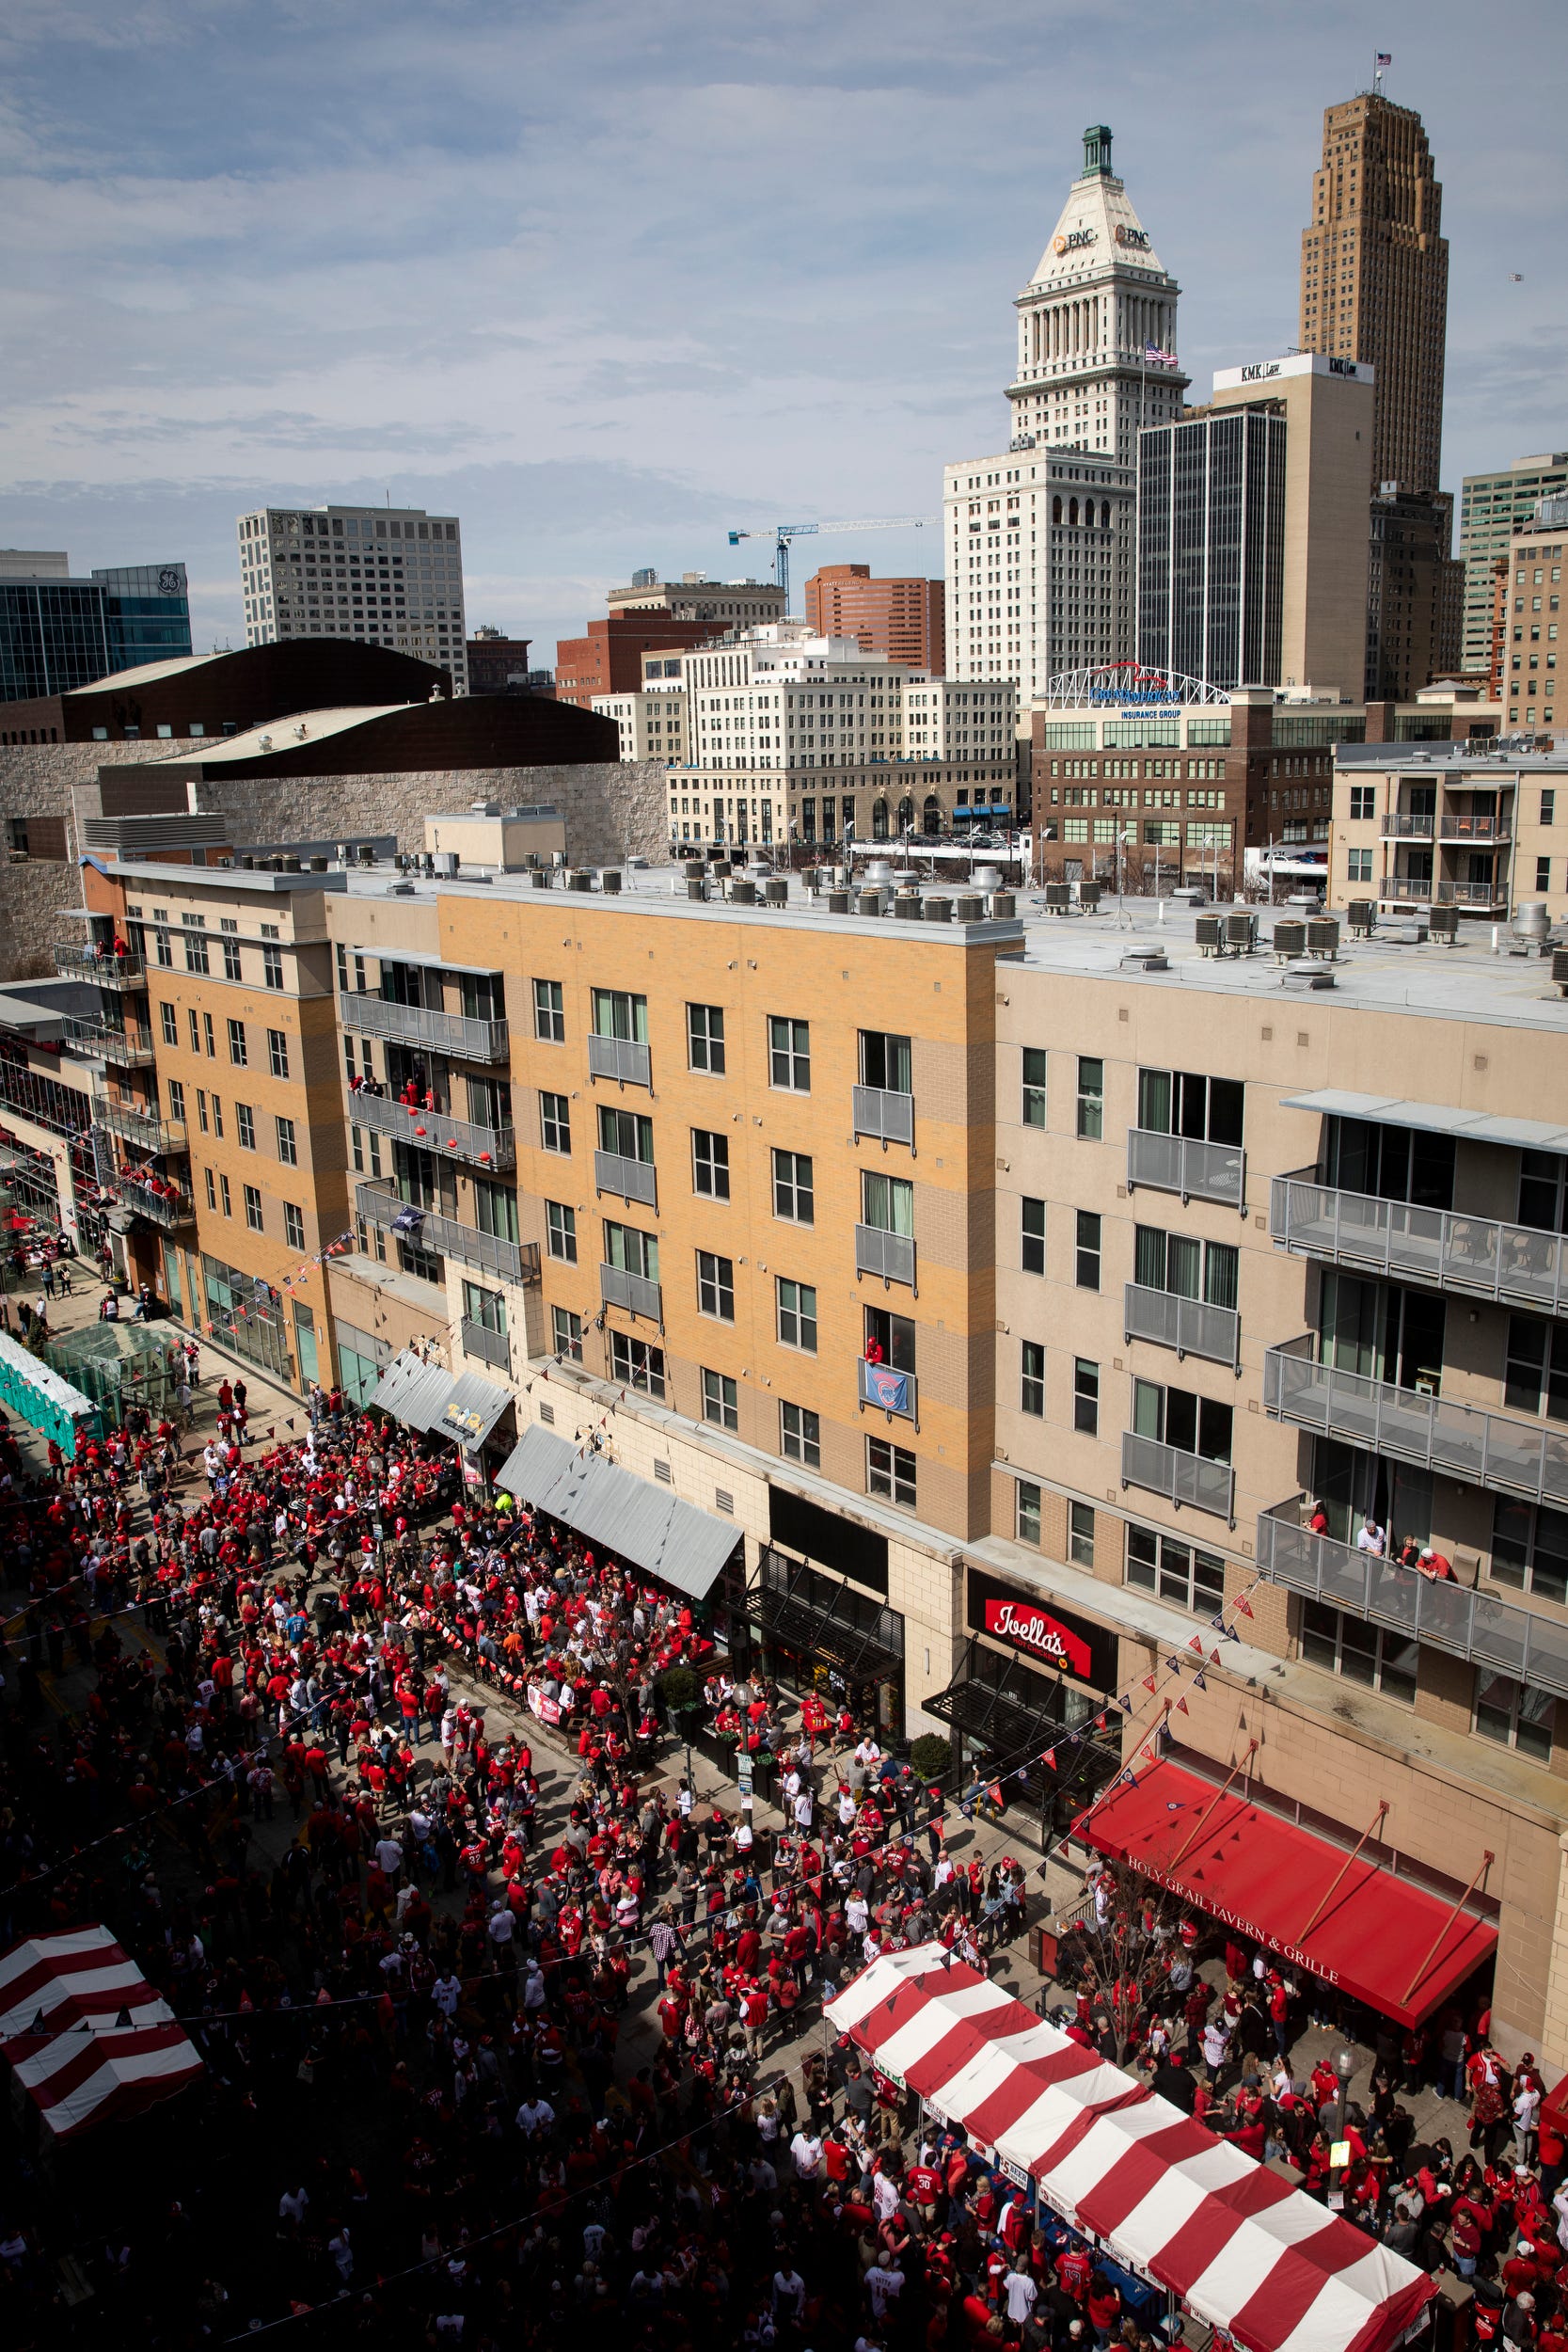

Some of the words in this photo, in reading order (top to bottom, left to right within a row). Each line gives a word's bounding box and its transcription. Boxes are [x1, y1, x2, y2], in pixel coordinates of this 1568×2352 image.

[1068, 229, 1095, 247] PNC
[1126, 228, 1149, 246] PNC
[1242, 364, 1262, 382] KMK
[1265, 363, 1280, 376] Law
[1329, 358, 1344, 374] KMK
[1121, 710, 1158, 720] INSURANCE
[1159, 709, 1181, 719] GROUP
[993, 1605, 1067, 1656] Joella's
[1012, 1636, 1026, 1649] HOT
[1027, 1644, 1058, 1664] CHICKEN
[1128, 1855, 1163, 1883] HOLY
[1165, 1877, 1208, 1911] GRAIL
[1210, 1901, 1266, 1943] TAVERN
[1268, 1936, 1281, 1952] &
[1284, 1945, 1340, 1985] GRILLE
[1000, 2155, 1010, 2174] $5
[1009, 2165, 1027, 2182] BEER
[918, 2179, 931, 2190] 30
